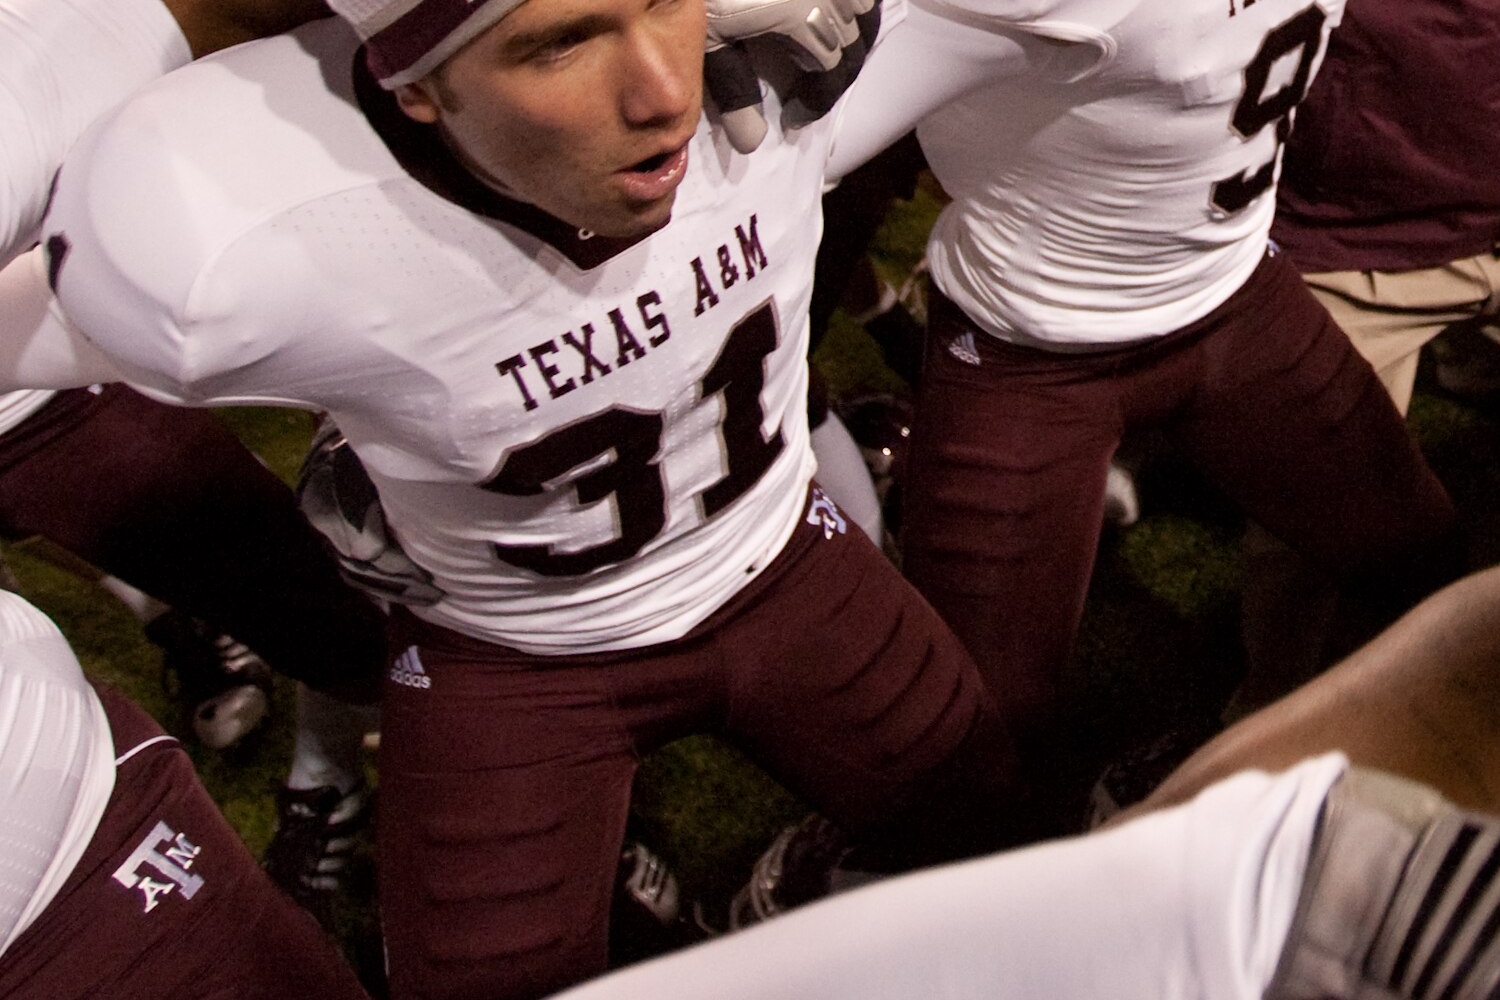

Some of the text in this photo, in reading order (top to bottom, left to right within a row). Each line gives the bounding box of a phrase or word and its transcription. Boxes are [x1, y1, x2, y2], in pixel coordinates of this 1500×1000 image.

[1208, 0, 1328, 217] 9
[495, 213, 768, 412] TEXAS A&M
[470, 294, 788, 578] 31
